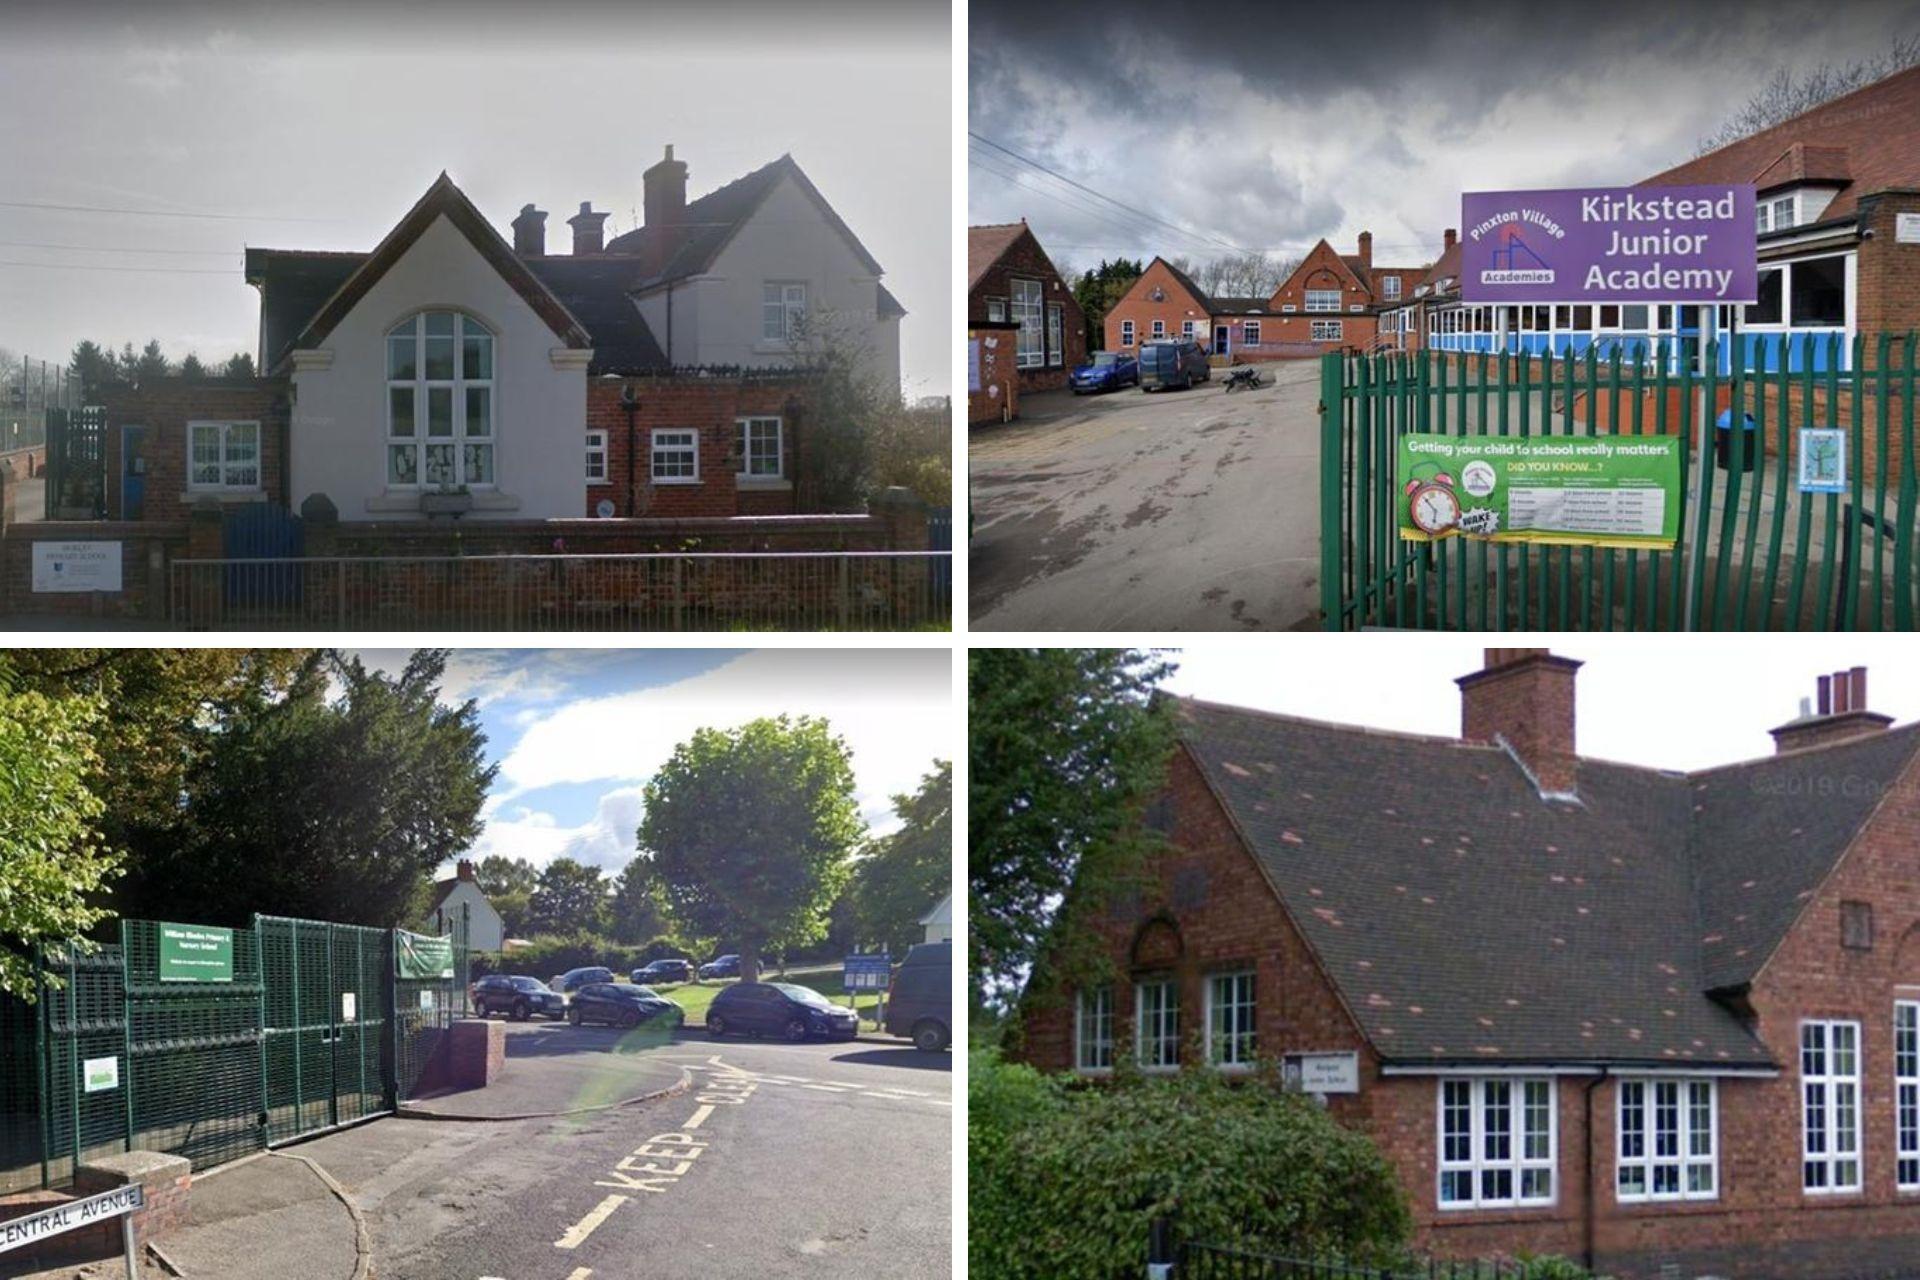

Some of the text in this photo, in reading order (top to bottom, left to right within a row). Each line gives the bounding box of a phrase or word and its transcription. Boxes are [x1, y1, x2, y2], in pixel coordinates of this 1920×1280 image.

[1582, 191, 1735, 222] Kirkstead
[1470, 208, 1565, 241] Pinxton Village
[1605, 229, 1708, 256] Junior
[1484, 272, 1552, 282] Academies
[1584, 263, 1733, 296] Academy
[1408, 441, 1669, 458] Getting your child to school really matters
[1507, 462, 1525, 472] DID
[1527, 462, 1551, 472] YOU
[1462, 512, 1490, 526] WAKE
[593, 1133, 709, 1192] KEEP
[0, 1188, 137, 1245] CENTRAL AVENUE
